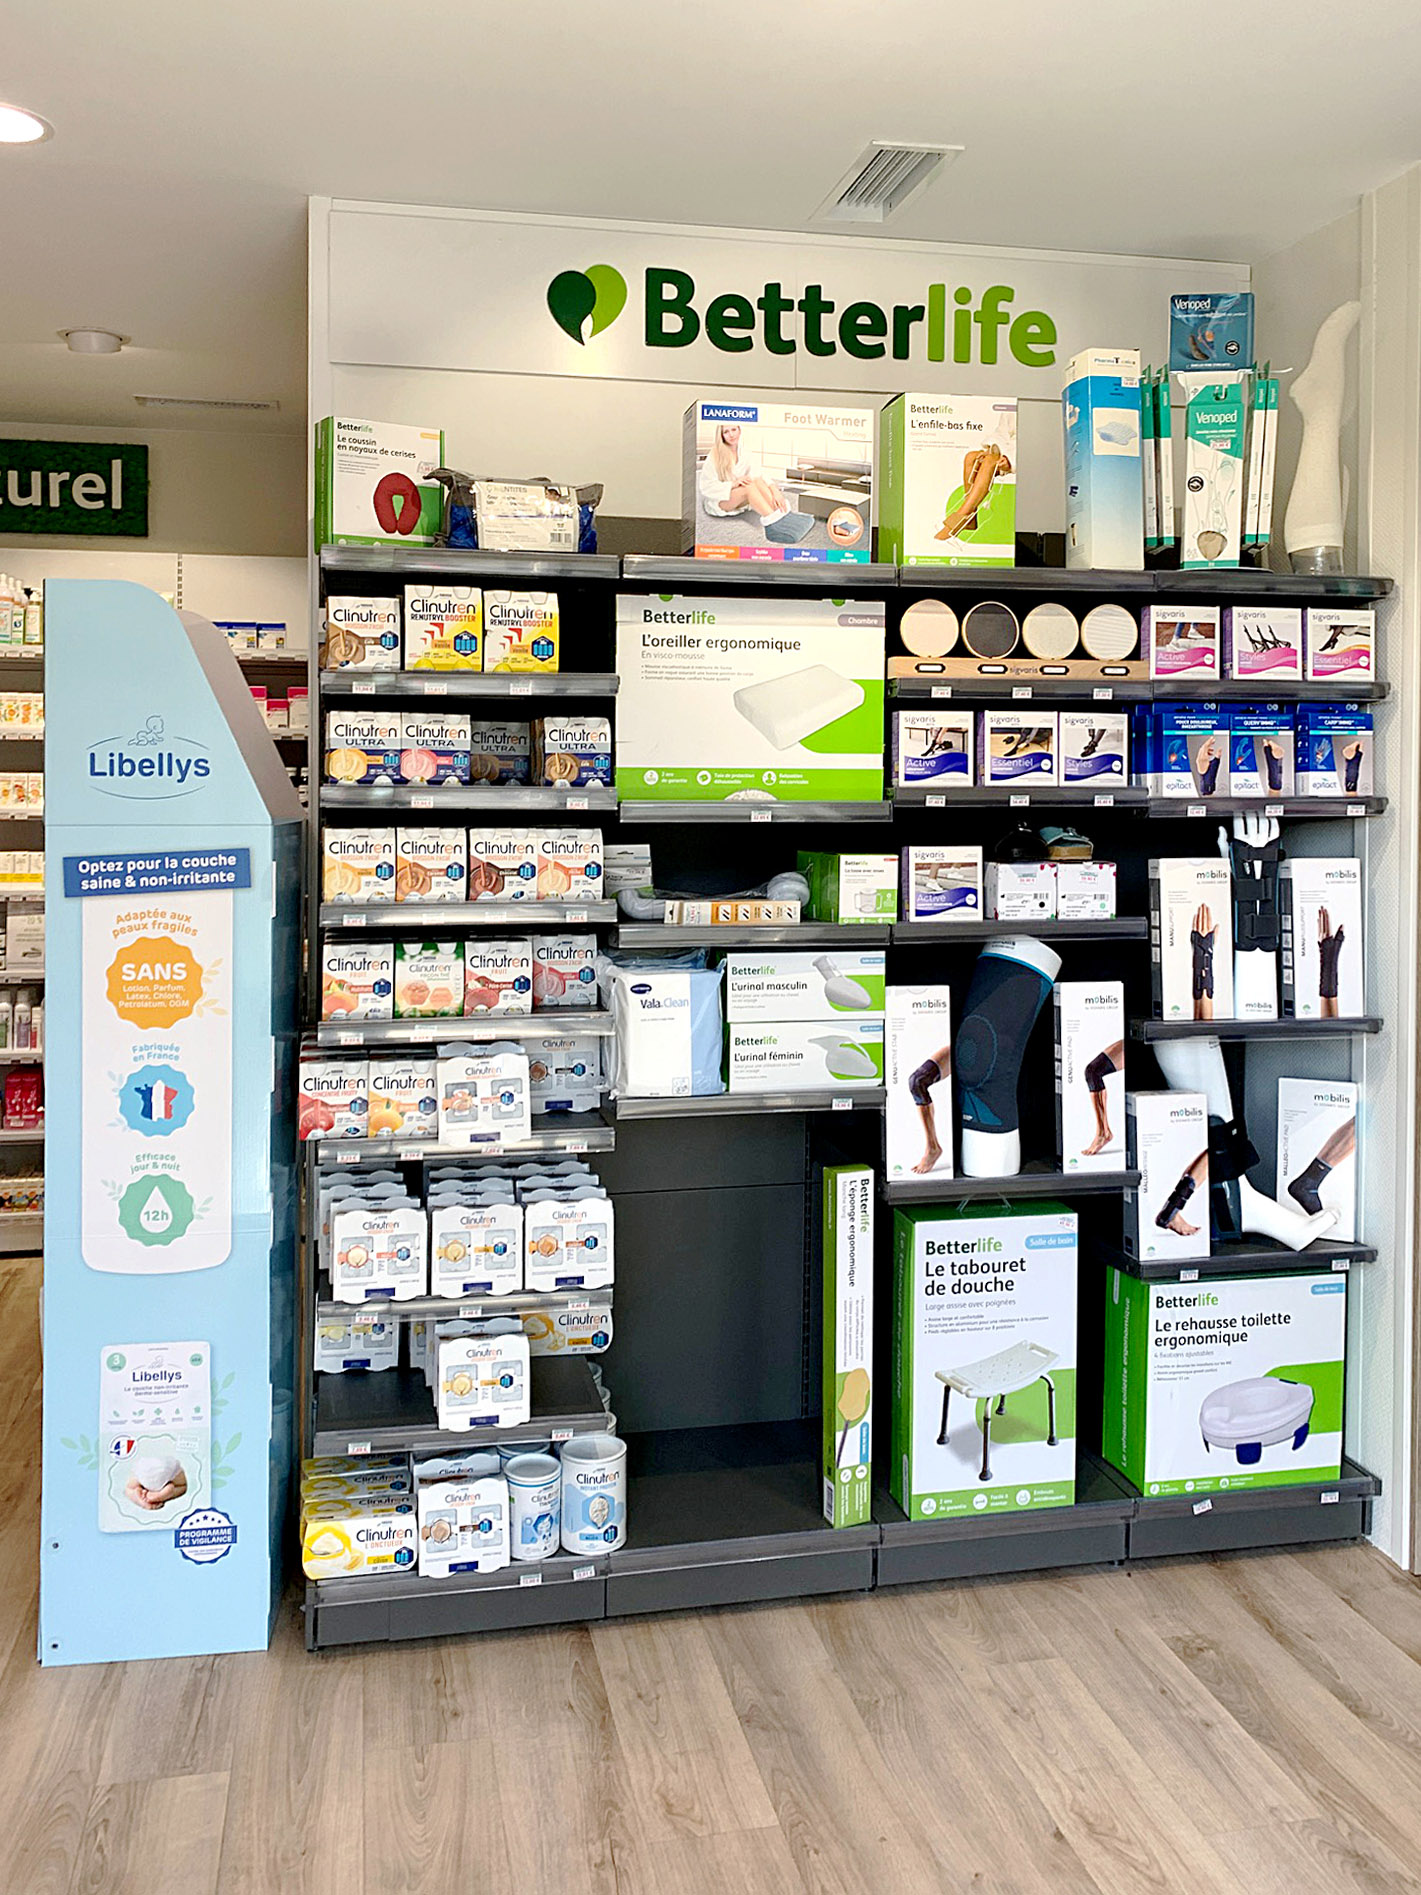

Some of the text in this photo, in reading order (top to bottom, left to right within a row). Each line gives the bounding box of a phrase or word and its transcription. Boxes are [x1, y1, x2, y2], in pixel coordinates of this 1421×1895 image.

[1174, 297, 1211, 311] Venoped
[645, 267, 1057, 367] Betterlife
[910, 404, 953, 415] Betterlife
[784, 412, 867, 428] Foot Warmer
[1195, 409, 1238, 426] Venoped
[337, 422, 373, 433] Betterlife
[911, 419, 983, 432] L'enfile-bas fixe
[337, 435, 377, 446] Le coussin
[348, 446, 377, 455] noyaux
[390, 450, 416, 459] cerises
[0, 459, 122, 510] urel
[411, 599, 476, 614] Clinutren
[333, 609, 396, 623] Clinutren
[411, 613, 476, 622] RENUTRYL BOOSTER
[643, 609, 716, 625] Betterlife
[1155, 610, 1186, 619] sigvaris
[1237, 611, 1267, 620] sigvaris
[1312, 614, 1341, 622] sigvaris
[848, 617, 878, 625] Chambre
[641, 634, 802, 653] L'oreiller ergonomique
[641, 651, 652, 660] En
[1157, 653, 1186, 661] Active
[1240, 653, 1266, 662] Styles
[1314, 655, 1352, 664] Essentiel
[1009, 666, 1039, 675] sigvaris
[904, 715, 935, 725] sigvaris
[990, 715, 1020, 725] sigvaris
[1064, 716, 1094, 726] sigvaris
[334, 724, 397, 738] Clinutren
[405, 724, 467, 739] Clinutren
[548, 728, 607, 742] Clinutren
[345, 738, 386, 746] ULTRA
[416, 739, 455, 747] ULTRA
[471, 731, 527, 745] Clinutren
[480, 745, 516, 753] ULTRA
[559, 743, 597, 751] ULTRA
[89, 752, 211, 783] Libellys
[906, 758, 936, 768] Active
[992, 758, 1034, 768] Essentiel
[1066, 759, 1093, 769] Styles
[329, 841, 391, 855] Clinutren
[401, 841, 462, 855] Clinutren
[474, 841, 534, 854] Clinutren
[541, 841, 600, 854] Clinutren
[914, 851, 945, 860] sigvaris
[78, 854, 237, 875] Optez pour la couche
[81, 870, 236, 890] saine & non-irritante
[1196, 870, 1228, 879] mobilis
[1325, 870, 1357, 879] mobilis
[917, 893, 946, 902] Active
[116, 908, 192, 924] Adaptée aux
[112, 920, 198, 939] peaux fragiles
[537, 946, 594, 960] Clinutren
[327, 958, 389, 972] Clinutren
[469, 954, 529, 969] Clinutren
[121, 962, 188, 981] SANS
[408, 963, 451, 973] Clinutren
[731, 966, 775, 976] Betterlife
[122, 983, 186, 993] Lotion, Parfum,
[731, 981, 808, 991] L'urinal masculin
[152, 992, 182, 1000] Chlore,
[1084, 995, 1119, 1004] mobilis
[169, 999, 189, 1007] OGM
[640, 997, 689, 1009] Vala Clean
[912, 999, 947, 1008] mobilis
[542, 1039, 576, 1049] Clinutren
[734, 1036, 778, 1046] Betterlife
[132, 1043, 181, 1054] Fabriquée
[132, 1052, 180, 1062] en France
[734, 1051, 804, 1062] L'urinal féminin
[465, 1066, 502, 1076] Clinutren
[303, 1077, 366, 1091] Clinutren
[373, 1075, 435, 1090] Clinutren
[1313, 1093, 1350, 1104] mobilis
[1170, 1107, 1203, 1117] mobilis
[135, 1152, 176, 1163] Efficace
[130, 1161, 181, 1175] jour & nuit
[859, 1178, 870, 1234] Betterlife
[144, 1211, 169, 1221] 12h
[460, 1215, 497, 1226] Clinutren
[552, 1210, 587, 1220] Clinutren
[362, 1220, 400, 1231] Clinutren
[848, 1179, 857, 1288] L'éponge ergonomique
[925, 1238, 1003, 1256] Betterlife
[1048, 1237, 1057, 1246] de
[925, 1258, 1026, 1277] Le tabouret
[924, 1277, 1014, 1296] de douche
[925, 1299, 1016, 1311] Large assise avec poignées
[1156, 1293, 1219, 1309] Betterlife
[558, 1313, 609, 1326] Clinutren
[1155, 1313, 1291, 1332] Le rehausse toilette
[1154, 1331, 1248, 1350] ergonomique
[466, 1347, 503, 1359] Clinutren
[112, 1355, 120, 1365] 3
[132, 1370, 182, 1383] Libellys
[576, 1470, 620, 1485] Clinutren
[445, 1493, 481, 1504] Clinutren
[179, 1528, 232, 1538] PROGRAMME
[356, 1527, 413, 1543] Clinutren
[191, 1536, 232, 1545] VIGILANCE
